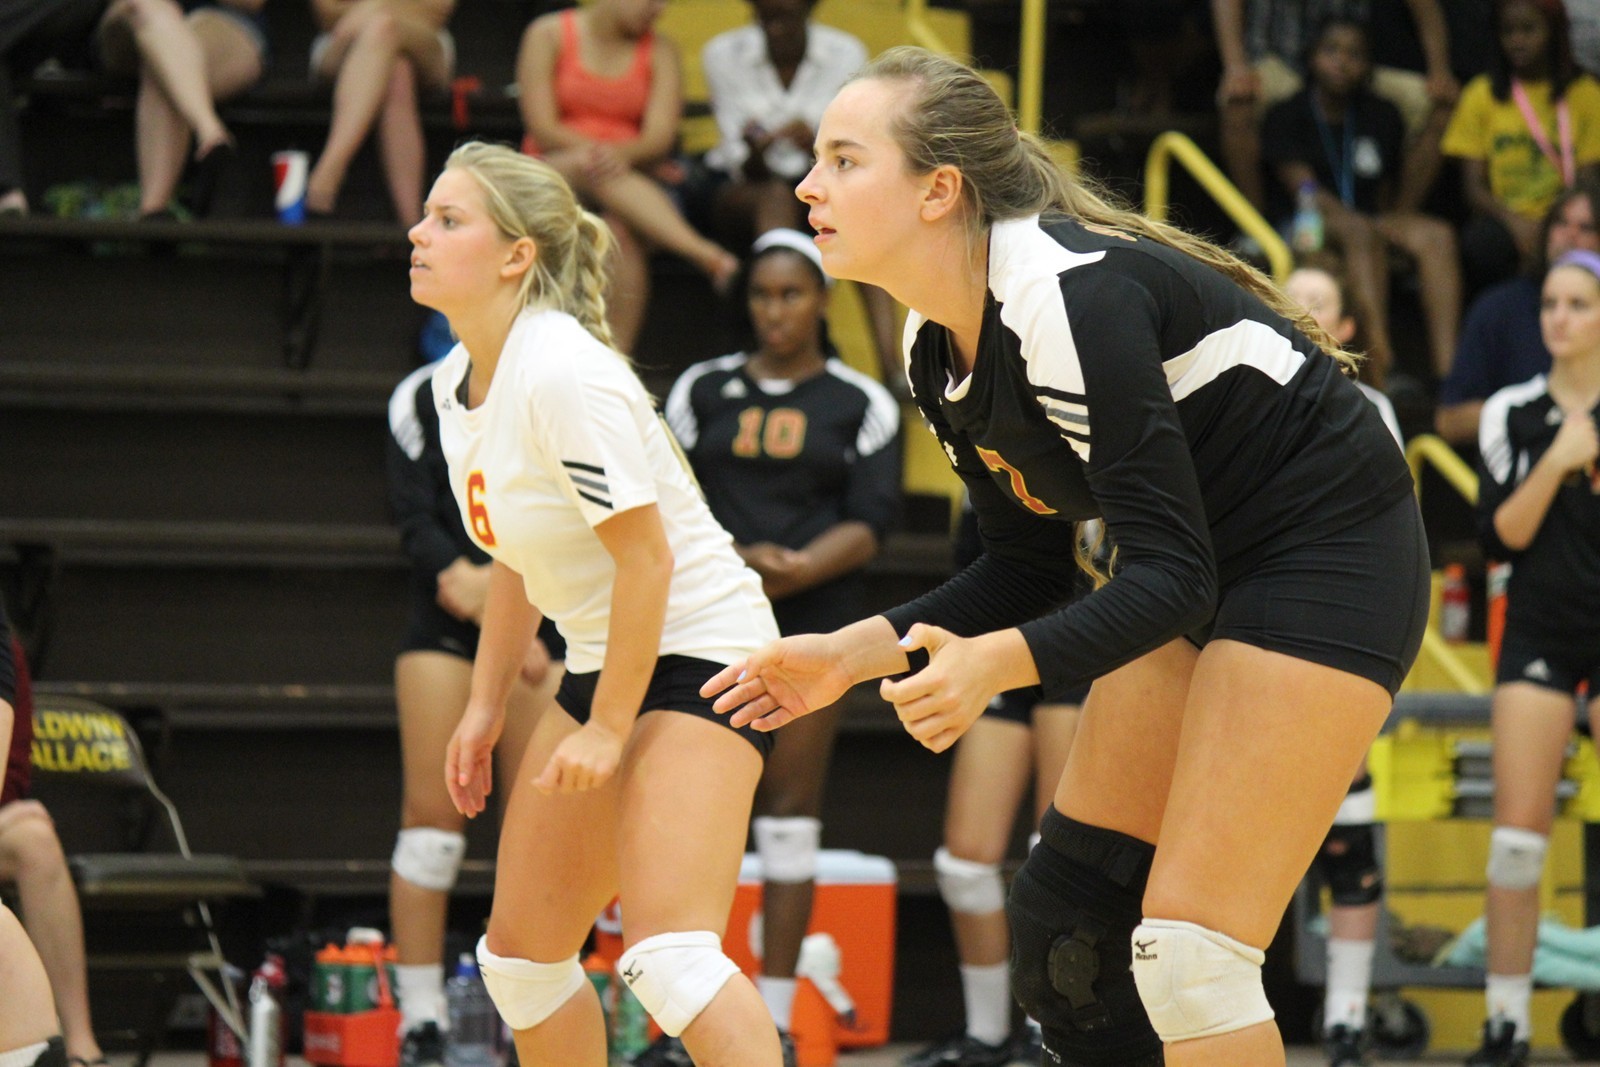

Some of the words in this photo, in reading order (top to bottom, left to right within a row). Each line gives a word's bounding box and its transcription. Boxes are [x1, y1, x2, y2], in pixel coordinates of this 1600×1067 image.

[731, 406, 808, 459] 10
[467, 469, 498, 547] 6
[975, 445, 1058, 514] 7
